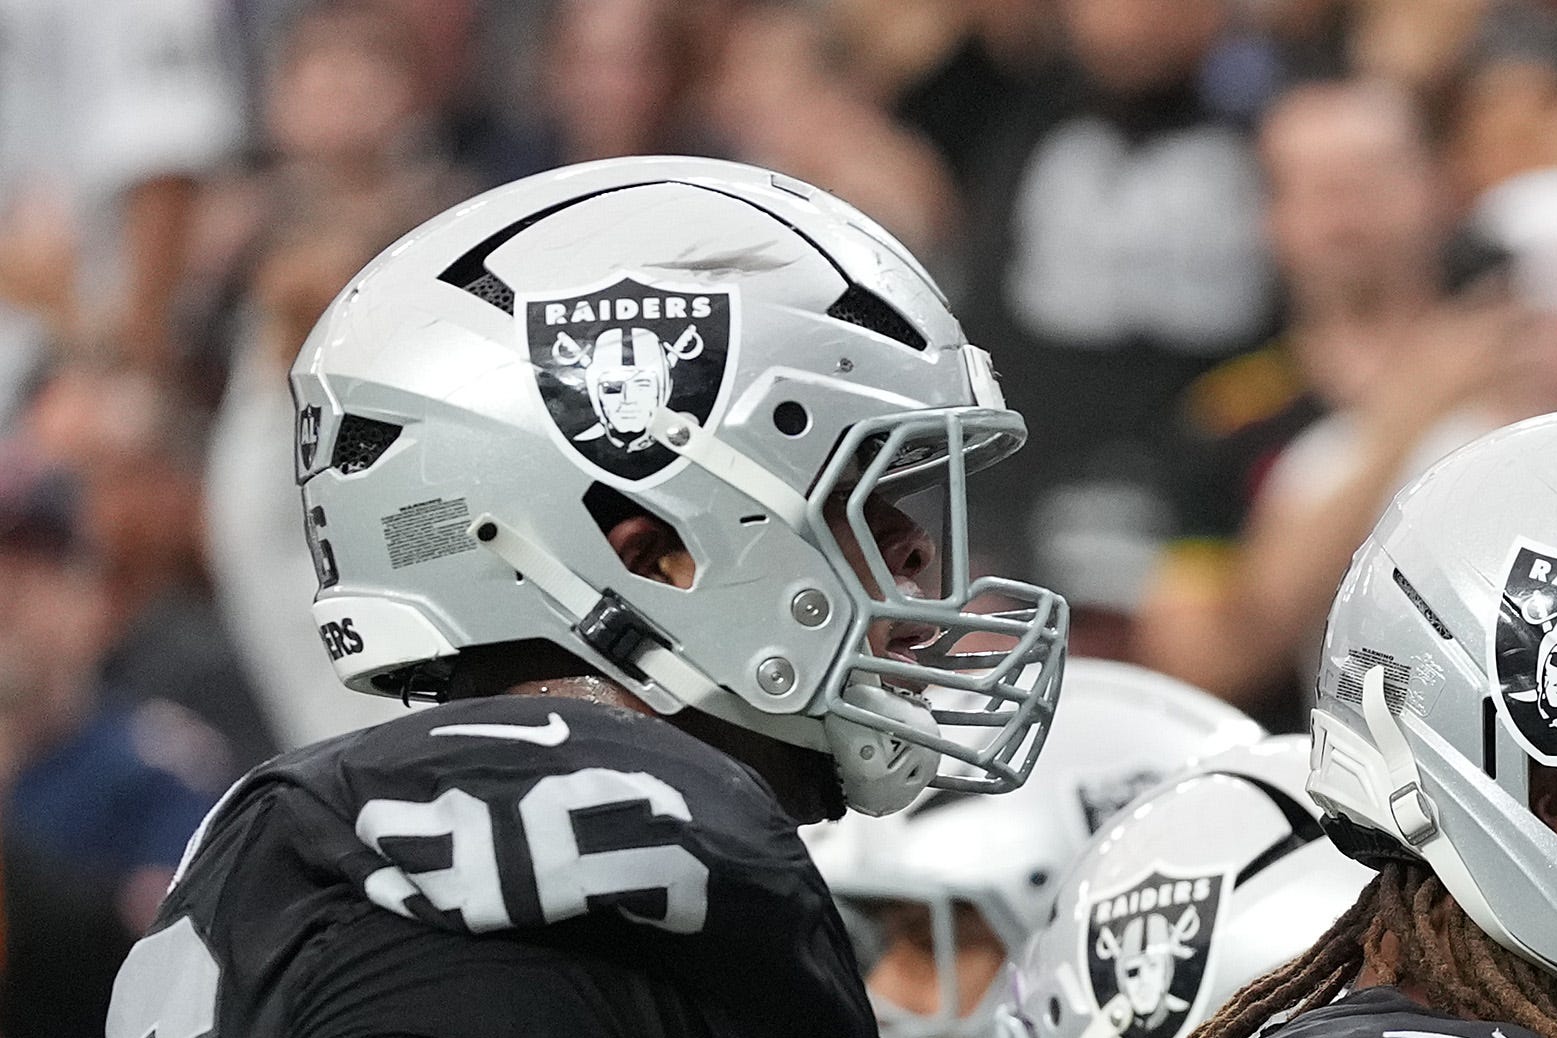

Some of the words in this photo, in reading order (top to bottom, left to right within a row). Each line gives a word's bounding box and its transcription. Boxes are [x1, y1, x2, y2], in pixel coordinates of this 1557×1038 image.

[545, 297, 712, 325] RAIDERS
[355, 767, 710, 934] 96
[1096, 878, 1210, 924] RAIDERS
